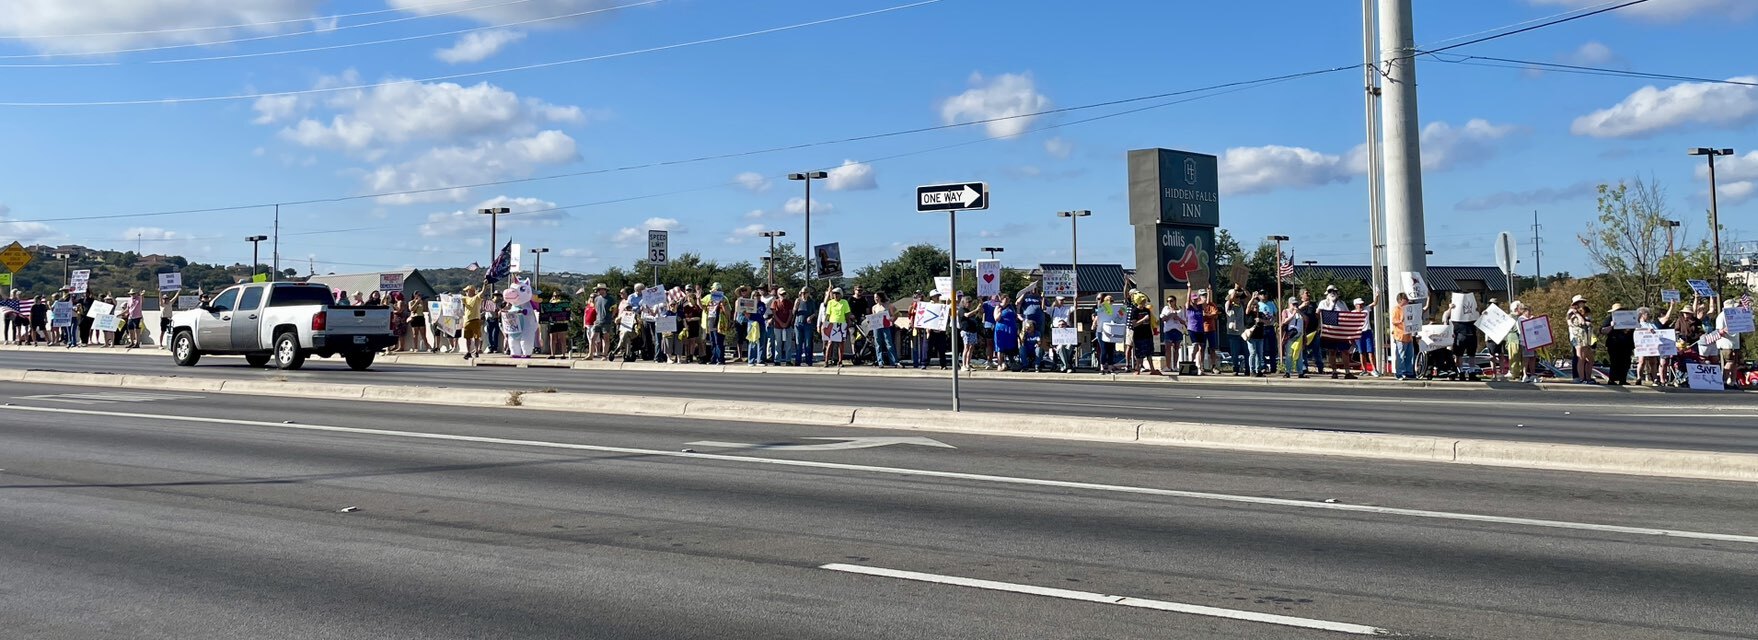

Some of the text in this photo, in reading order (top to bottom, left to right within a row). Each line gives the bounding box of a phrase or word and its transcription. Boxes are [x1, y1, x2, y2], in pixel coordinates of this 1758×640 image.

[924, 192, 962, 204] ONE WAY
[1165, 188, 1217, 203] HIDDEN FALLS
[1182, 203, 1201, 218] INN
[651, 250, 666, 262] 35
[1695, 364, 1717, 374] SAVE
